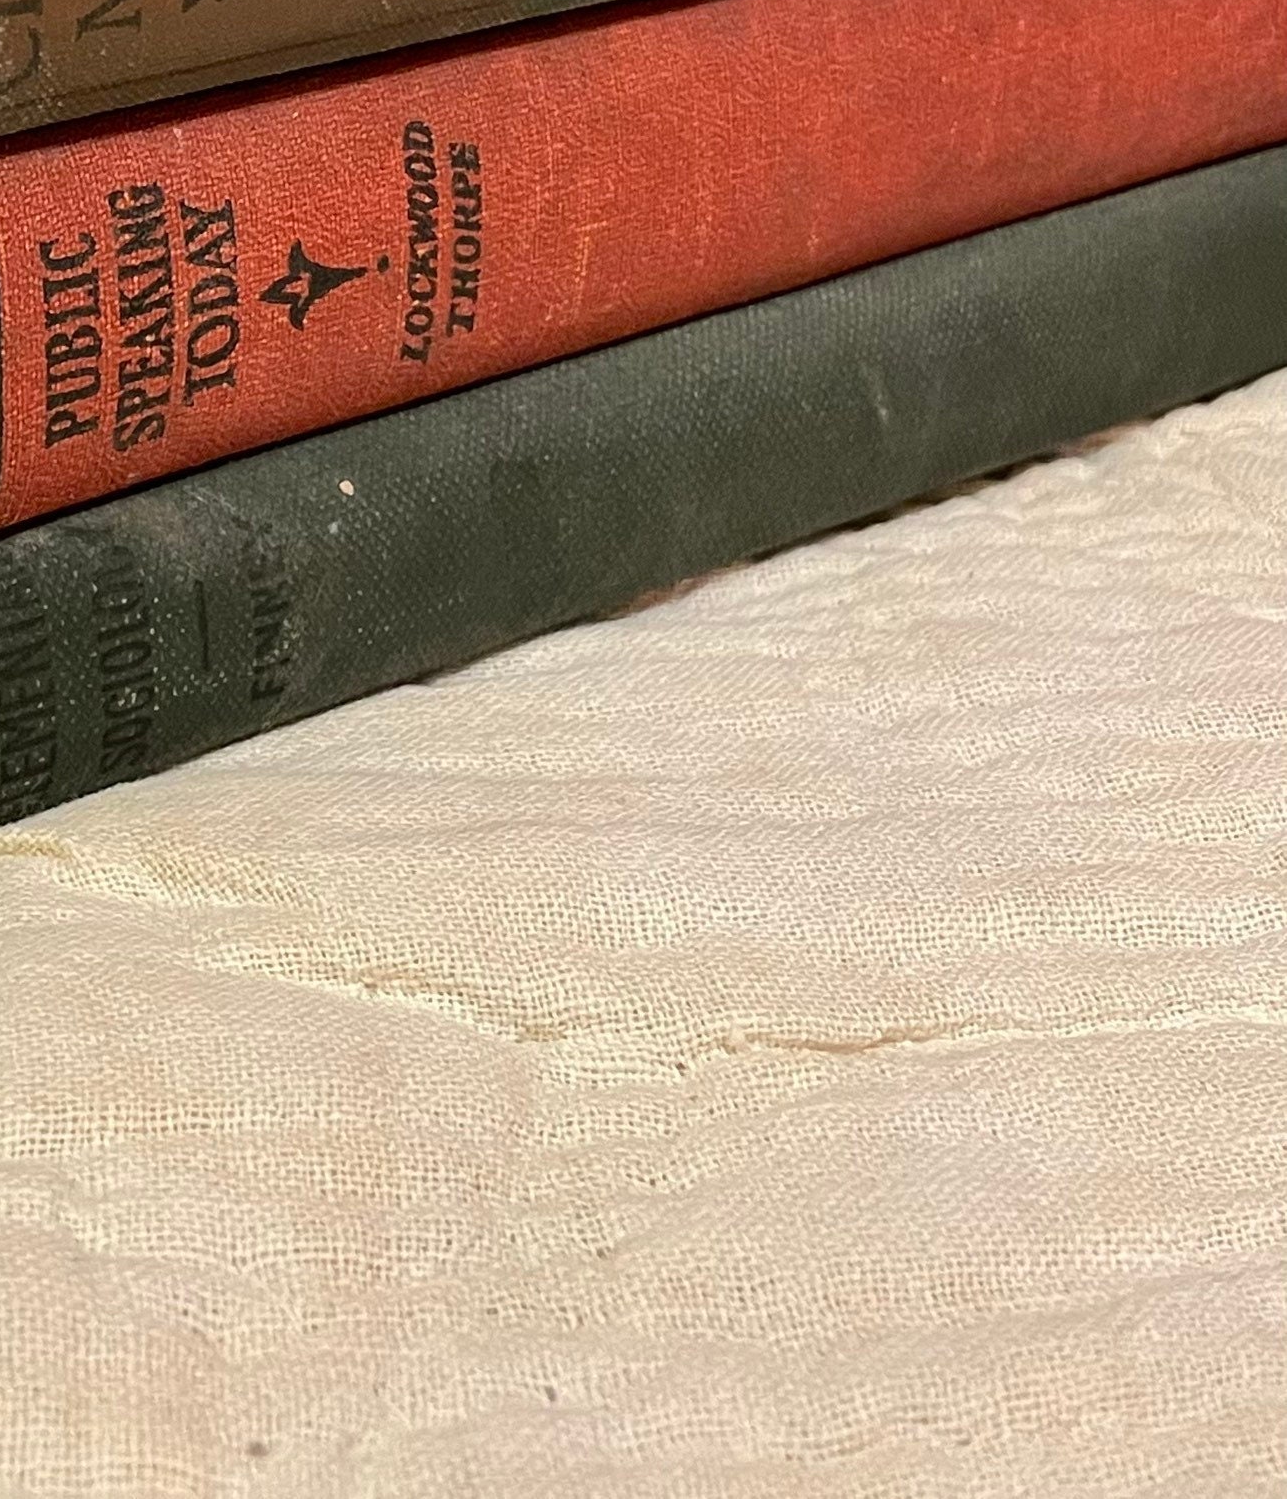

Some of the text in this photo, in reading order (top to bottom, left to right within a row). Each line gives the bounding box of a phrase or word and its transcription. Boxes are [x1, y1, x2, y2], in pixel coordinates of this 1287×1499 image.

[39, 231, 102, 450] PUBLIC
[107, 180, 175, 452] SPEAKING
[178, 198, 241, 407] TODAY
[400, 119, 440, 366] LOCKWOOD
[446, 141, 482, 337] THORPE
